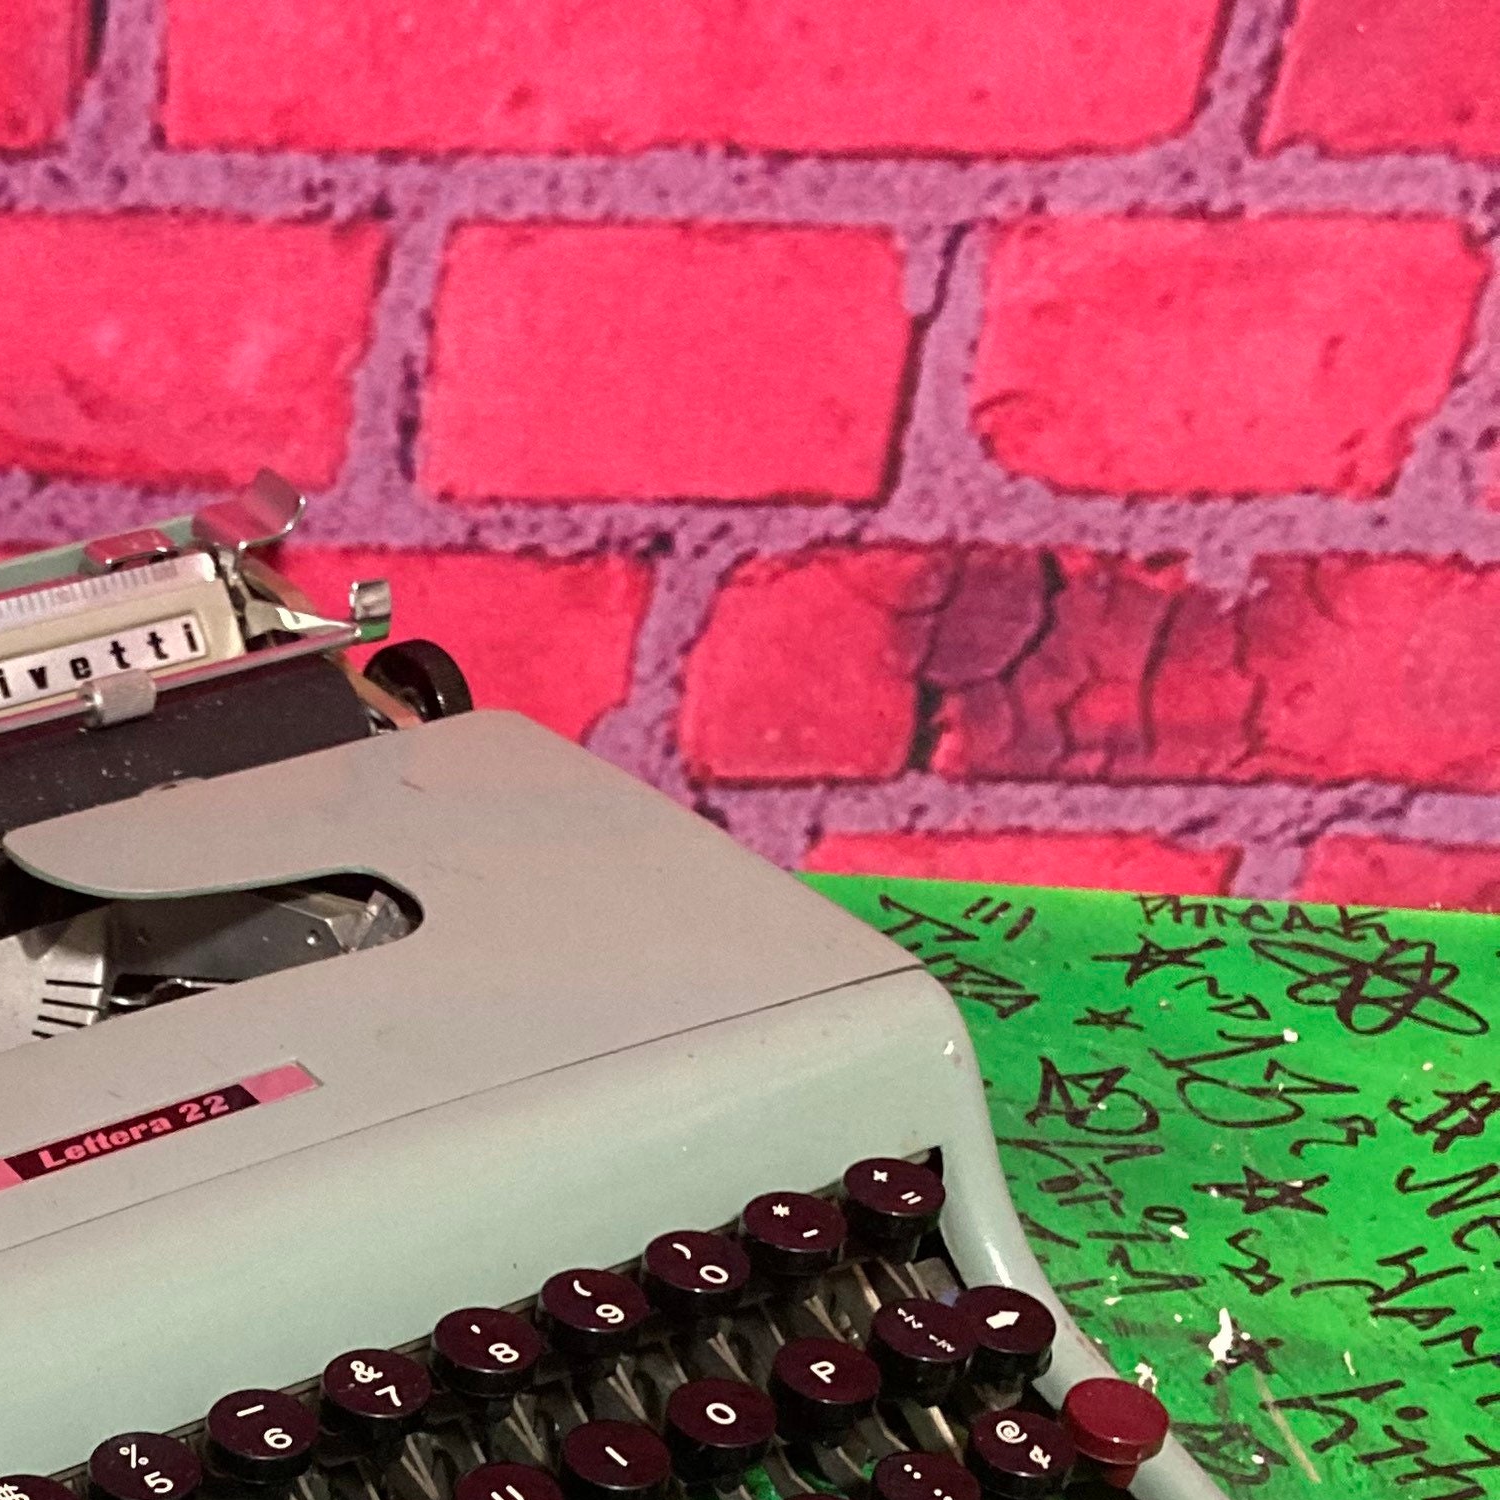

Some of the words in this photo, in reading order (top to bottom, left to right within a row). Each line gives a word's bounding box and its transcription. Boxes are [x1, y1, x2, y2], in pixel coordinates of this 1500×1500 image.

[37, 1116, 173, 1170] Lettera
[178, 1094, 232, 1128] 22
[595, 1303, 625, 1324] 9
[488, 1342, 520, 1364] 8
[350, 1360, 384, 1384] &
[809, 1360, 836, 1384] P
[374, 1384, 402, 1407] 7
[705, 1402, 737, 1425] O
[263, 1427, 293, 1450] 6
[995, 1420, 1028, 1444] @
[119, 1443, 149, 1469] %
[605, 1446, 628, 1467] I
[143, 1470, 174, 1494] 5
